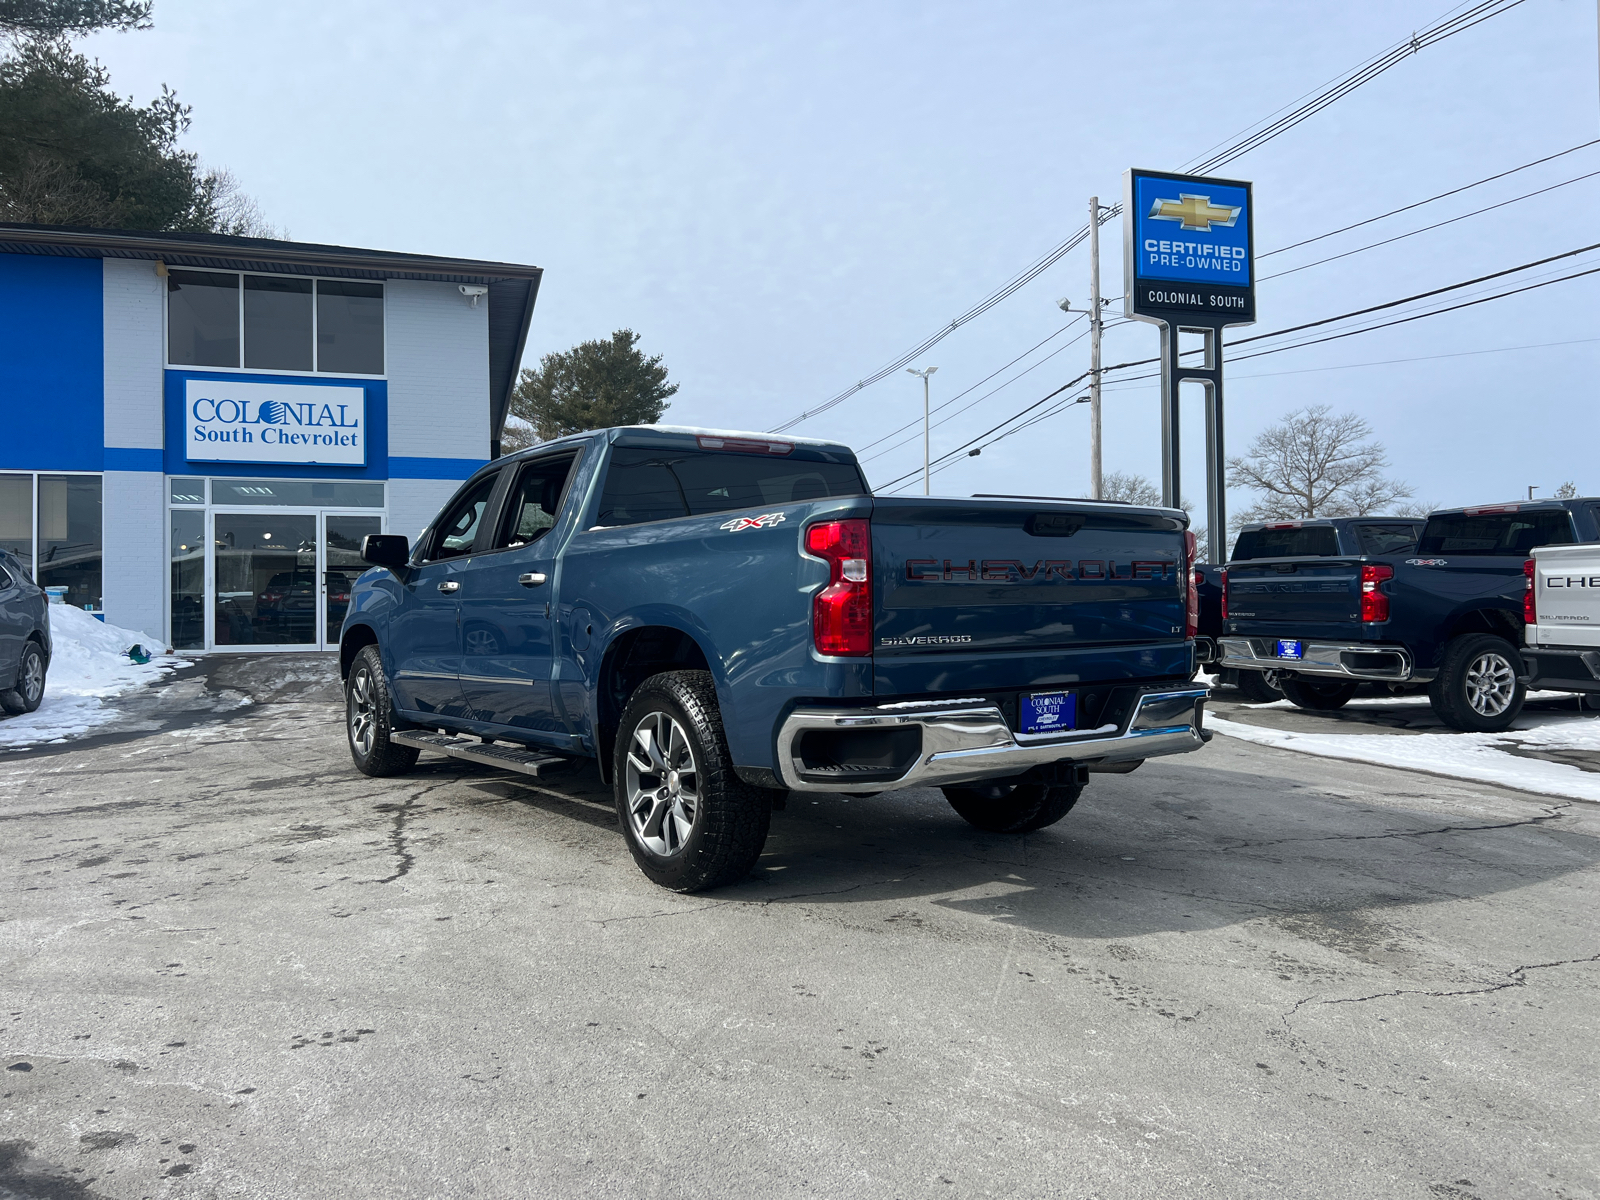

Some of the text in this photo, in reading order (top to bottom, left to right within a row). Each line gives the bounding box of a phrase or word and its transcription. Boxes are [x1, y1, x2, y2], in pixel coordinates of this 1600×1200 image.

[1144, 239, 1246, 259] CERTIFIED
[1150, 253, 1241, 272] PRE-OWNED
[1148, 290, 1245, 308] COLONIAL SOUTH
[192, 398, 358, 428] COLONIAL
[194, 425, 358, 446] South Chevrolet
[905, 559, 1175, 581] CHEVROLET
[1171, 625, 1183, 634] LT
[880, 635, 972, 646] SILVERADO
[1031, 696, 1066, 707] COLONIAL
[1036, 705, 1060, 715] SOUTH
